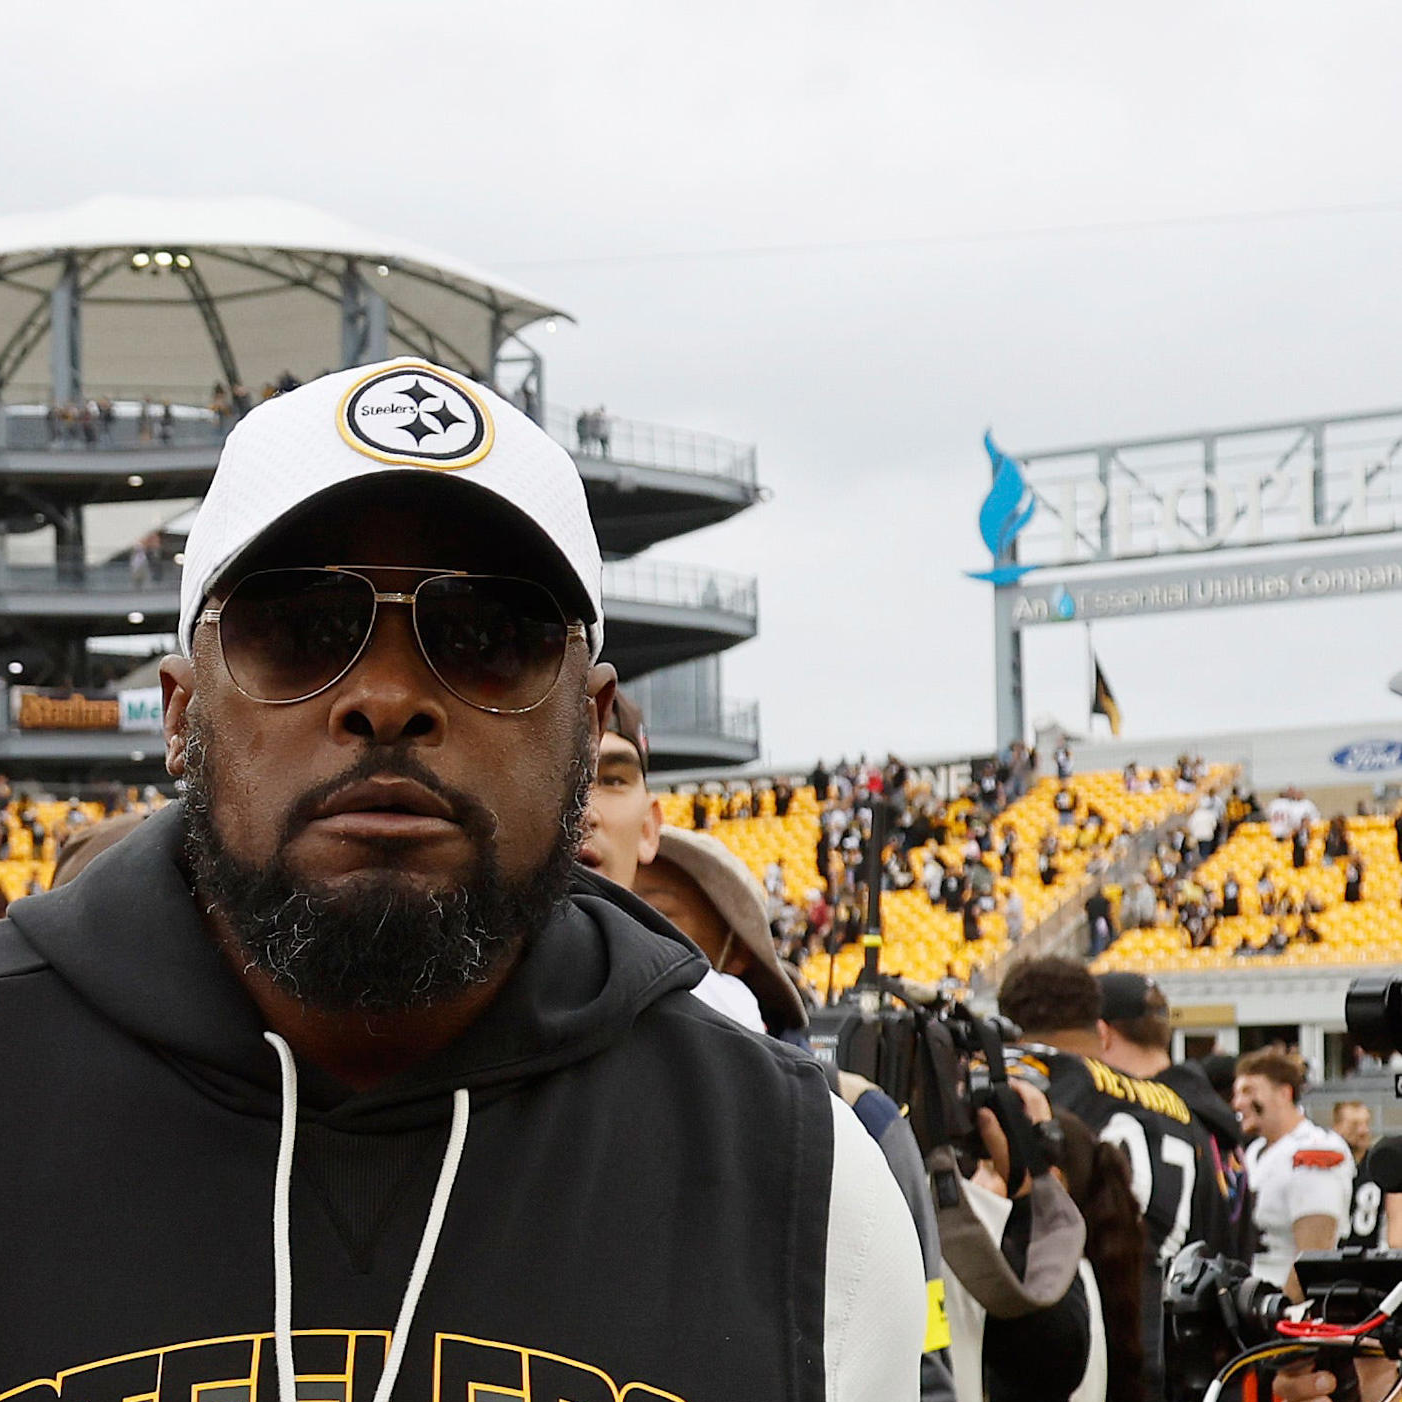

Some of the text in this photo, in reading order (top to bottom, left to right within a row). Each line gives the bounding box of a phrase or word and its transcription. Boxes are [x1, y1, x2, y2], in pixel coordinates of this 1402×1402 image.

[361, 403, 417, 417] Steelers
[1013, 595, 1049, 622] An
[1198, 573, 1290, 604] Utilities
